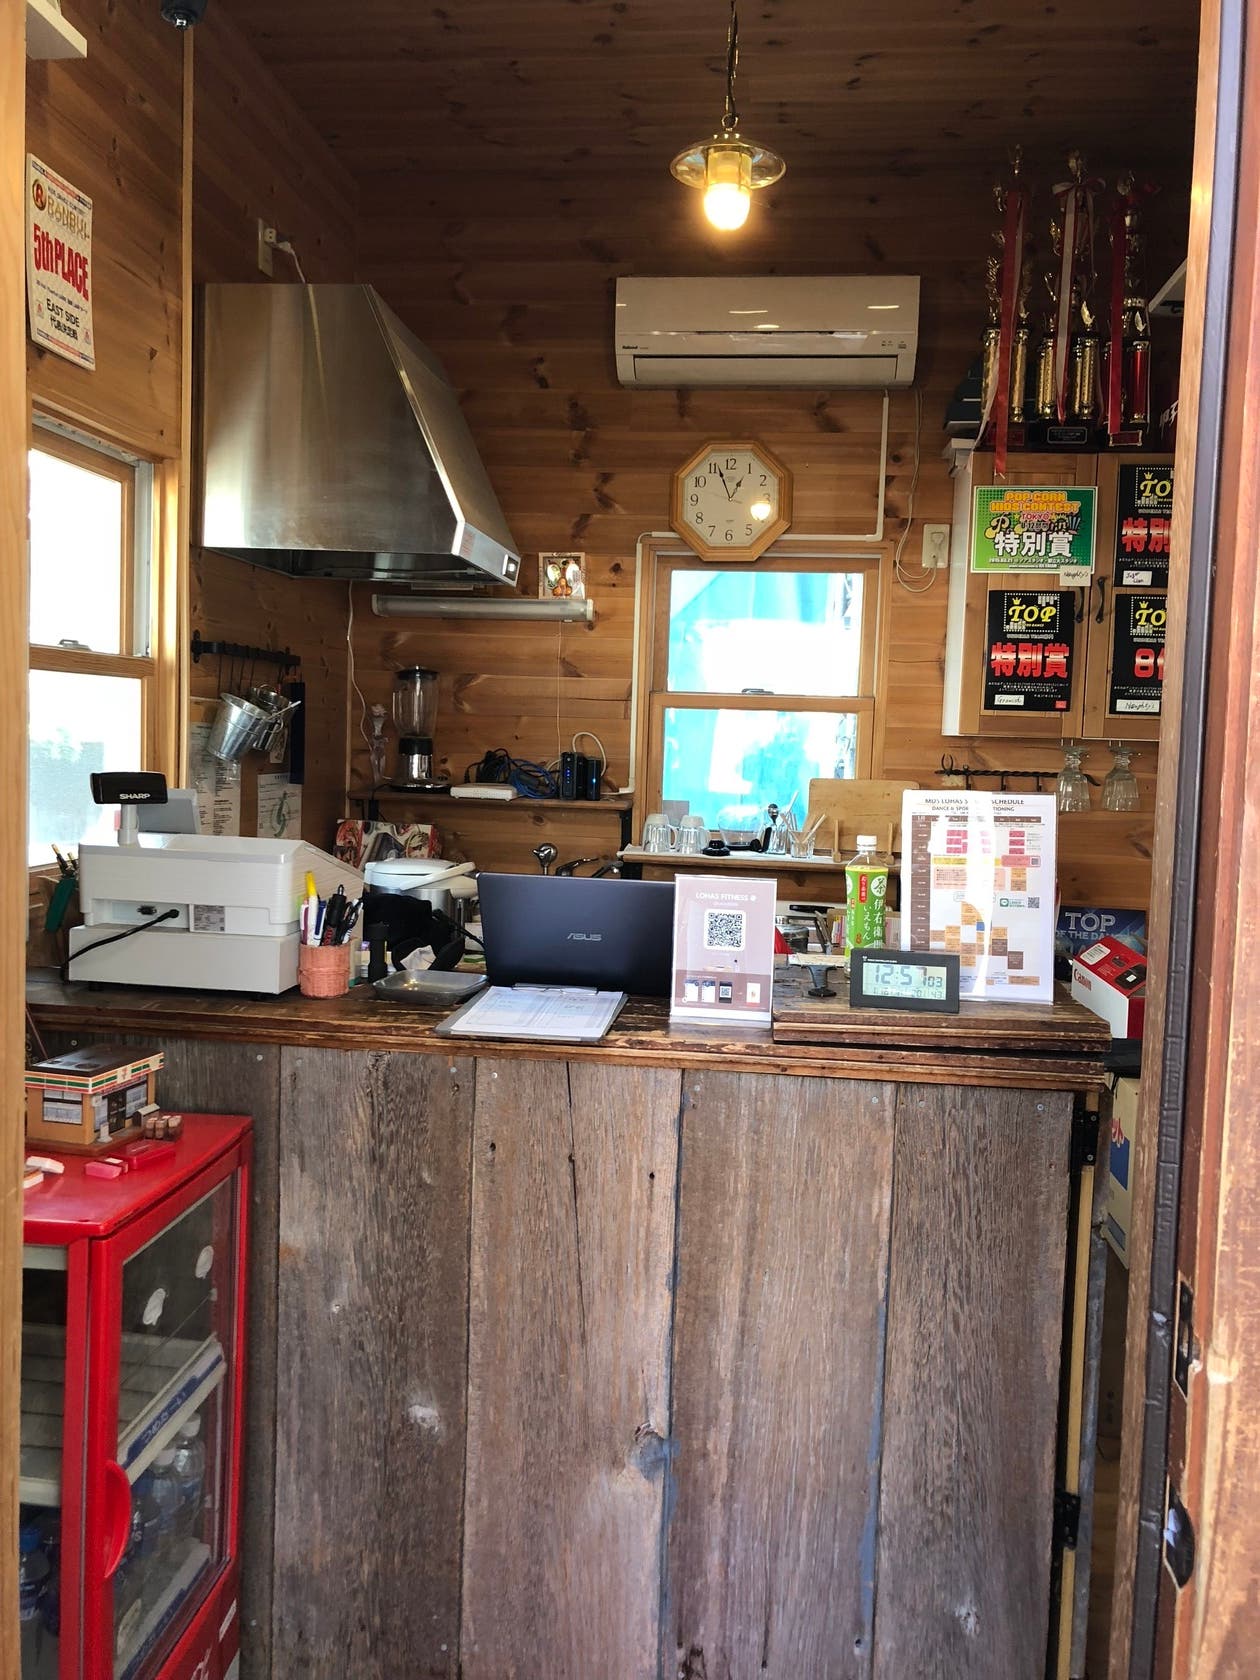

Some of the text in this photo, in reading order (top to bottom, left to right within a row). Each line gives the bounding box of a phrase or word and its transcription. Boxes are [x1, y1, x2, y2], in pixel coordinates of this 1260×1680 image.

[33, 222, 54, 274] 5th
[54, 237, 89, 302] PLACE
[46, 298, 63, 318] EAST
[65, 310, 80, 328] SIDE
[708, 462, 718, 474] 11
[725, 458, 737, 470] 12
[748, 462, 752, 475] 1
[694, 475, 707, 488] 10
[759, 474, 767, 487] 2
[690, 493, 699, 506] 9
[763, 493, 771, 505] 3
[1005, 490, 1067, 502] POP CORN
[990, 501, 1080, 513] KIDS CONTEST
[695, 511, 704, 524] 8
[1021, 513, 1050, 521] TOKYO
[708, 525, 716, 537] 7
[724, 529, 733, 542] 6
[745, 524, 753, 536] 5
[994, 531, 1073, 558] 特別賞
[1008, 604, 1057, 622] TOP
[990, 641, 1070, 679] 特別賞
[873, 877, 886, 894] 茶
[695, 891, 749, 902] LOHAS FITNESS
[863, 905, 872, 940] いえもん
[1065, 911, 1116, 932] TOP
[567, 932, 602, 941] ASUS
[1068, 931, 1089, 939] THE
[875, 964, 943, 988] 12:57 03
[1074, 968, 1092, 991] Canon
